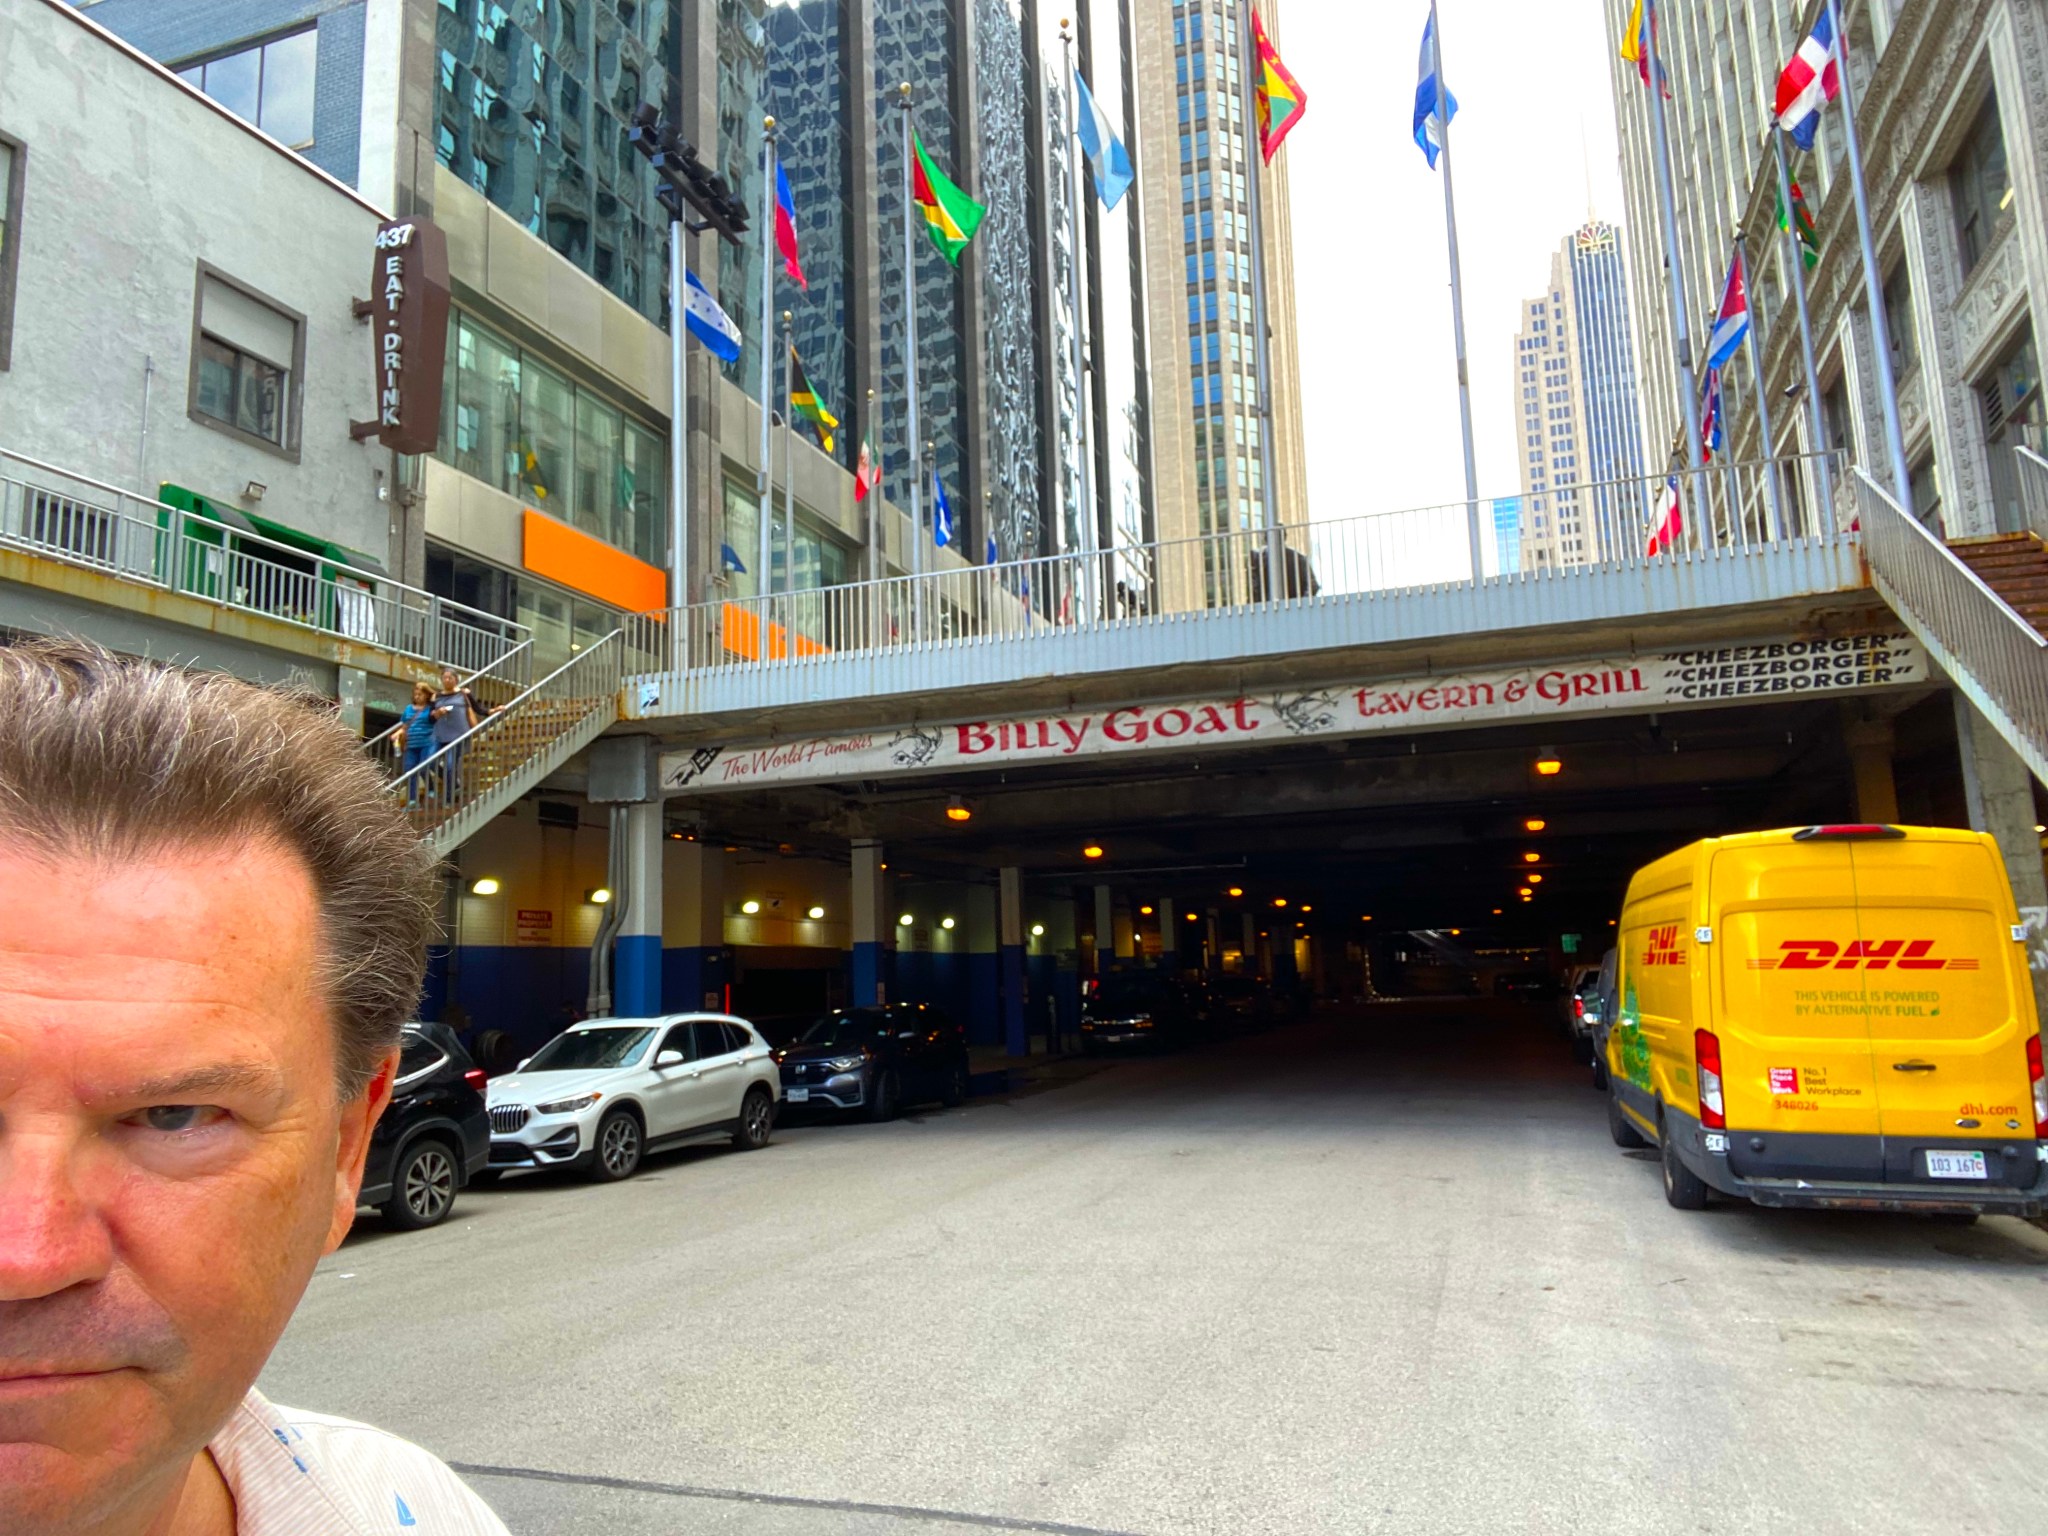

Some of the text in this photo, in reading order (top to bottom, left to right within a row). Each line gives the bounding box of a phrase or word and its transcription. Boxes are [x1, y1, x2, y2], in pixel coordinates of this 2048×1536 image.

[375, 223, 415, 249] 437
[382, 256, 404, 426] EAT DRINK
[1503, 679, 1530, 703] &
[722, 734, 874, 780] The World Famous
[1646, 925, 1680, 966] DHL
[1778, 940, 1948, 970] DHL
[1794, 990, 1940, 1003] THIS VEHICLE IS POWERED
[1795, 1004, 1810, 1016] BY
[1814, 1004, 1892, 1016] ALTERNATIVE
[1803, 1067, 1820, 1076] No.
[1804, 1077, 1827, 1086] Best
[1806, 1087, 1862, 1097] Workplace
[1960, 1103, 2018, 1116] dhl.com
[1931, 1158, 1951, 1172] 103
